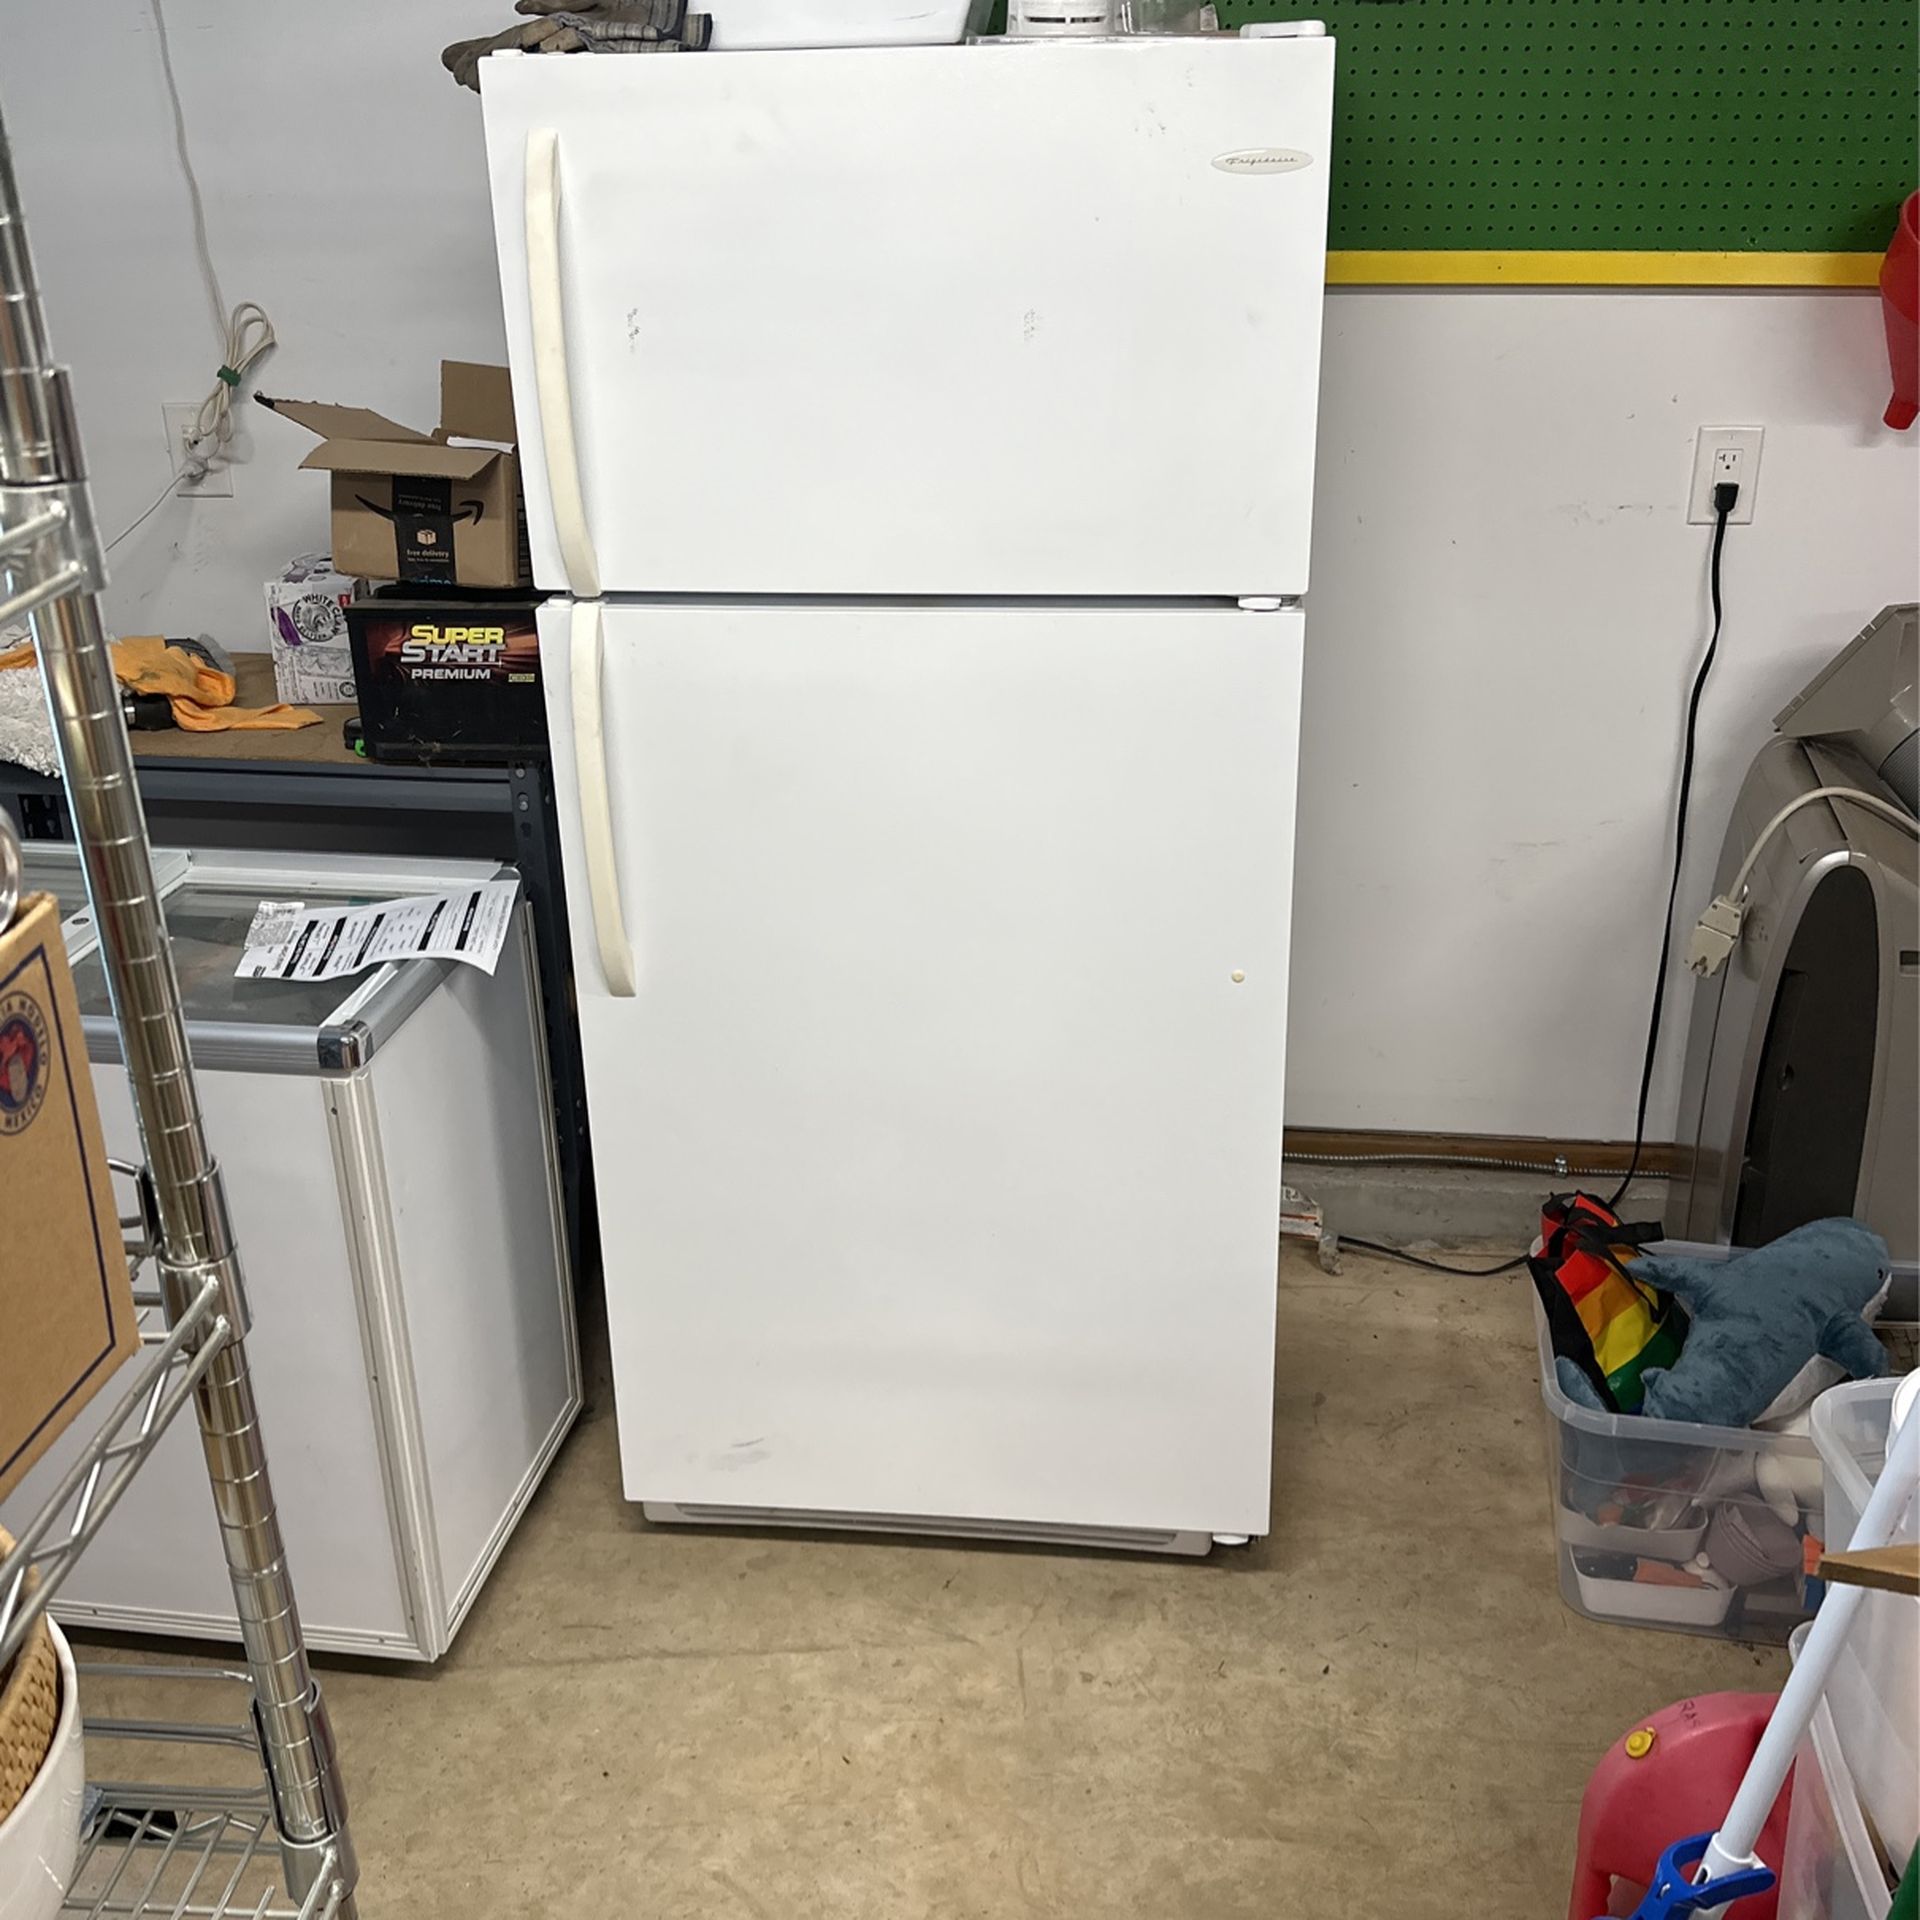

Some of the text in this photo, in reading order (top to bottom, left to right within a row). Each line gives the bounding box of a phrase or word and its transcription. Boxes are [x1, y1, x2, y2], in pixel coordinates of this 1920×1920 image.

[421, 549, 449, 559] delivery
[302, 594, 334, 608] WHITE
[330, 606, 342, 635] CLAW
[411, 624, 504, 646] SUPER
[400, 641, 506, 662] START
[411, 668, 491, 680] PREMIUM
